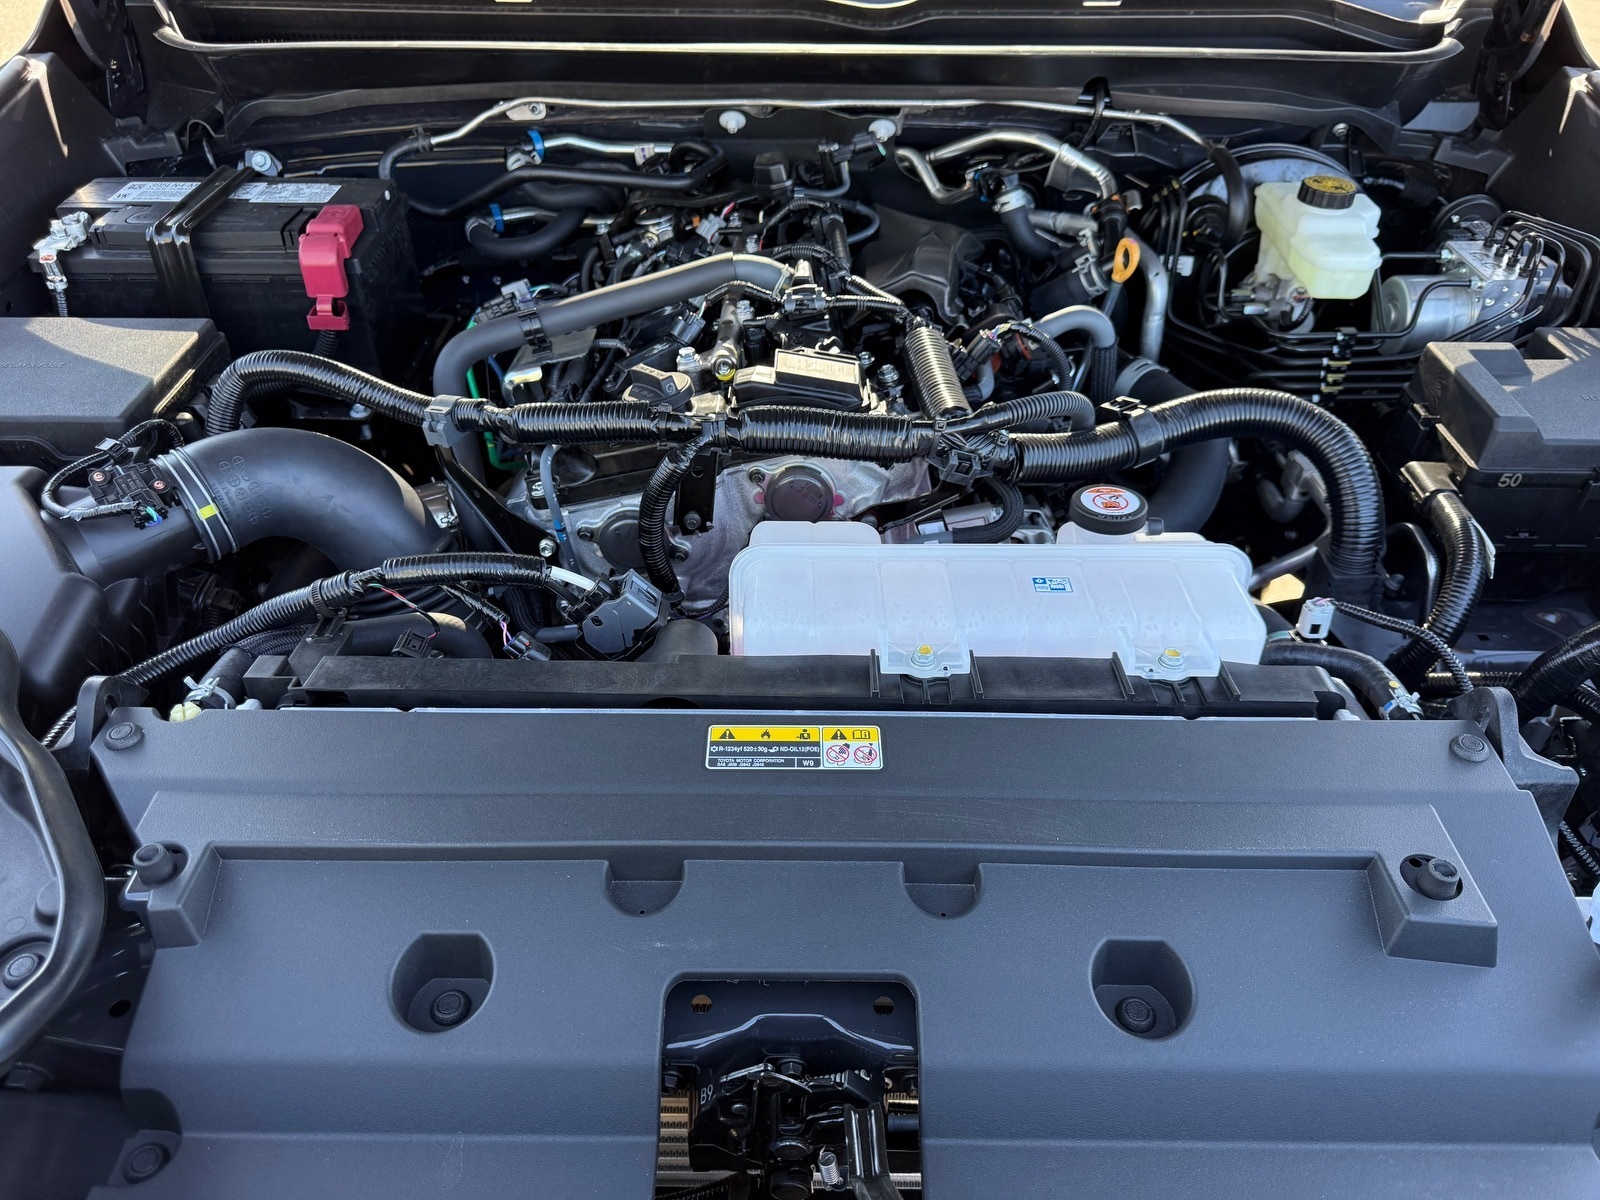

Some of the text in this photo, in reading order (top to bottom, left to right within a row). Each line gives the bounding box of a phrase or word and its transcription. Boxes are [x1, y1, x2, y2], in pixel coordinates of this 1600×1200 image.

[1497, 473, 1523, 488] 50
[719, 745, 743, 753] R-1234yf
[700, 1084, 714, 1105] B9
